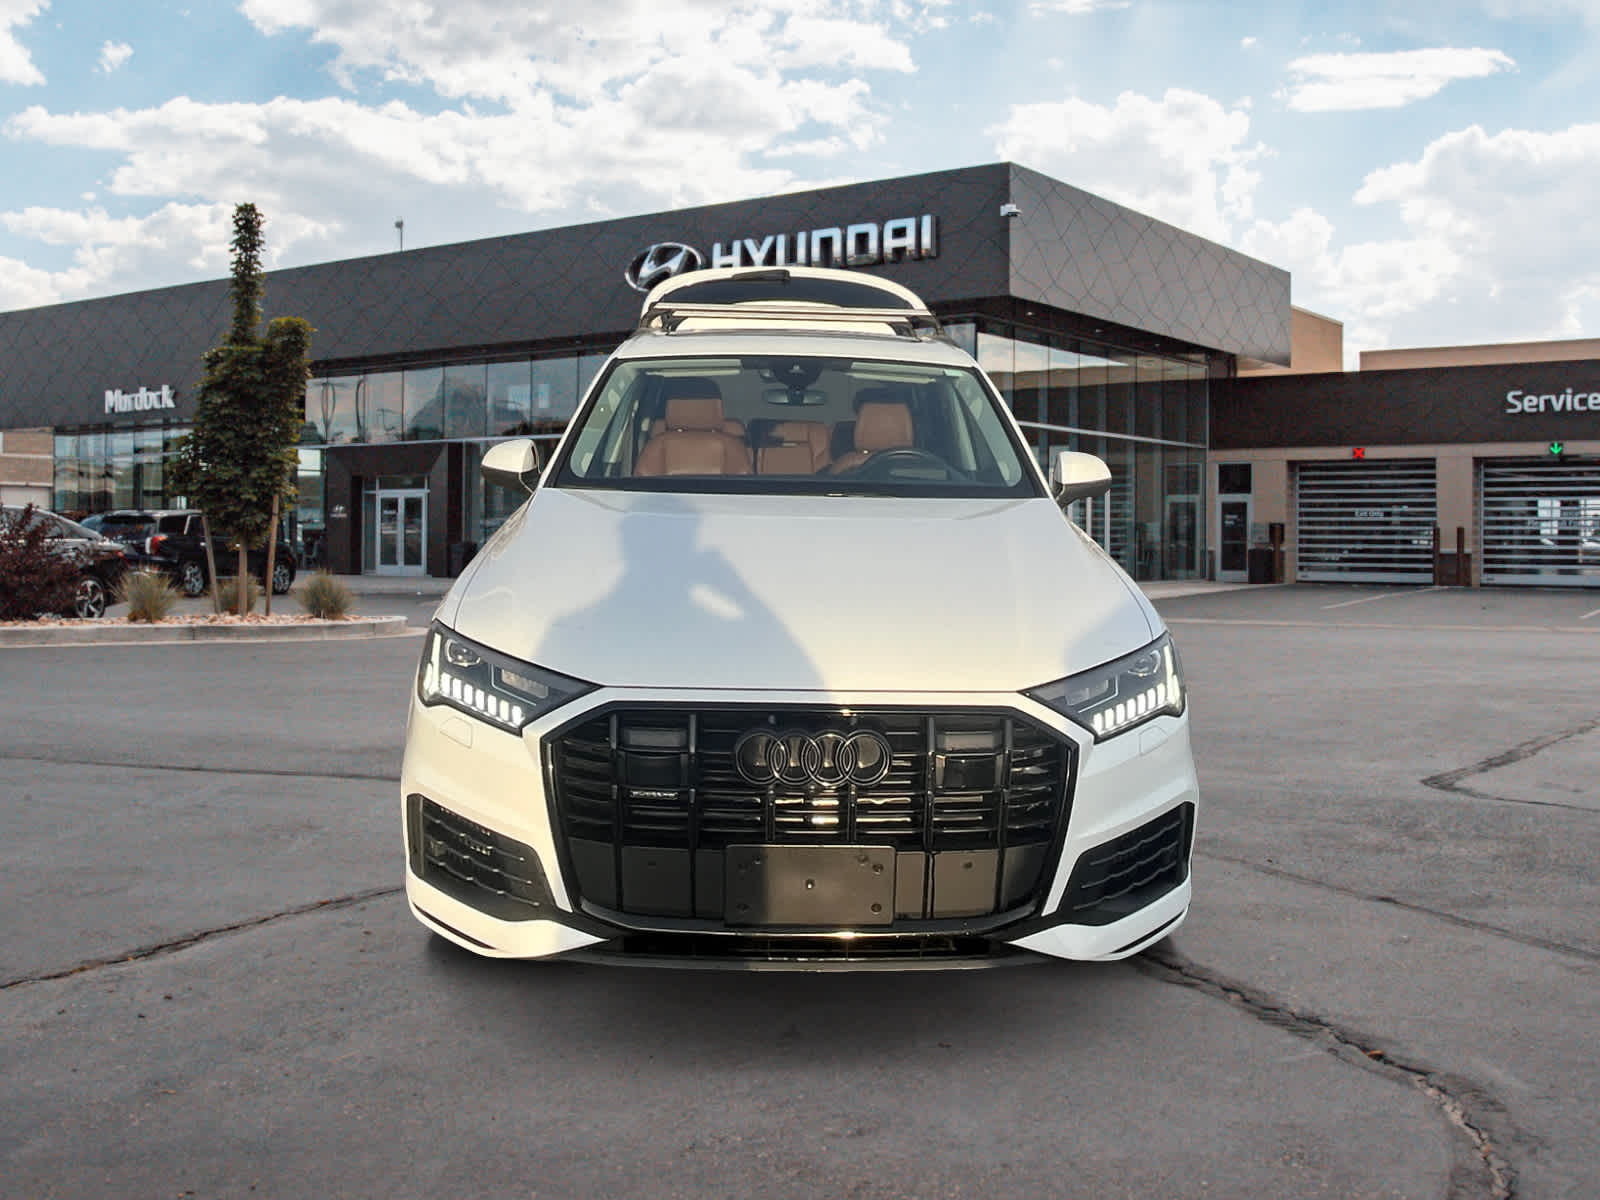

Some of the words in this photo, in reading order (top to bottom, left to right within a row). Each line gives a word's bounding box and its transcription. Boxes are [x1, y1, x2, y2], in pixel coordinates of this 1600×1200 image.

[712, 214, 938, 269] HYUNDAI
[104, 384, 176, 414] Murdock
[1505, 387, 1600, 414] Service
